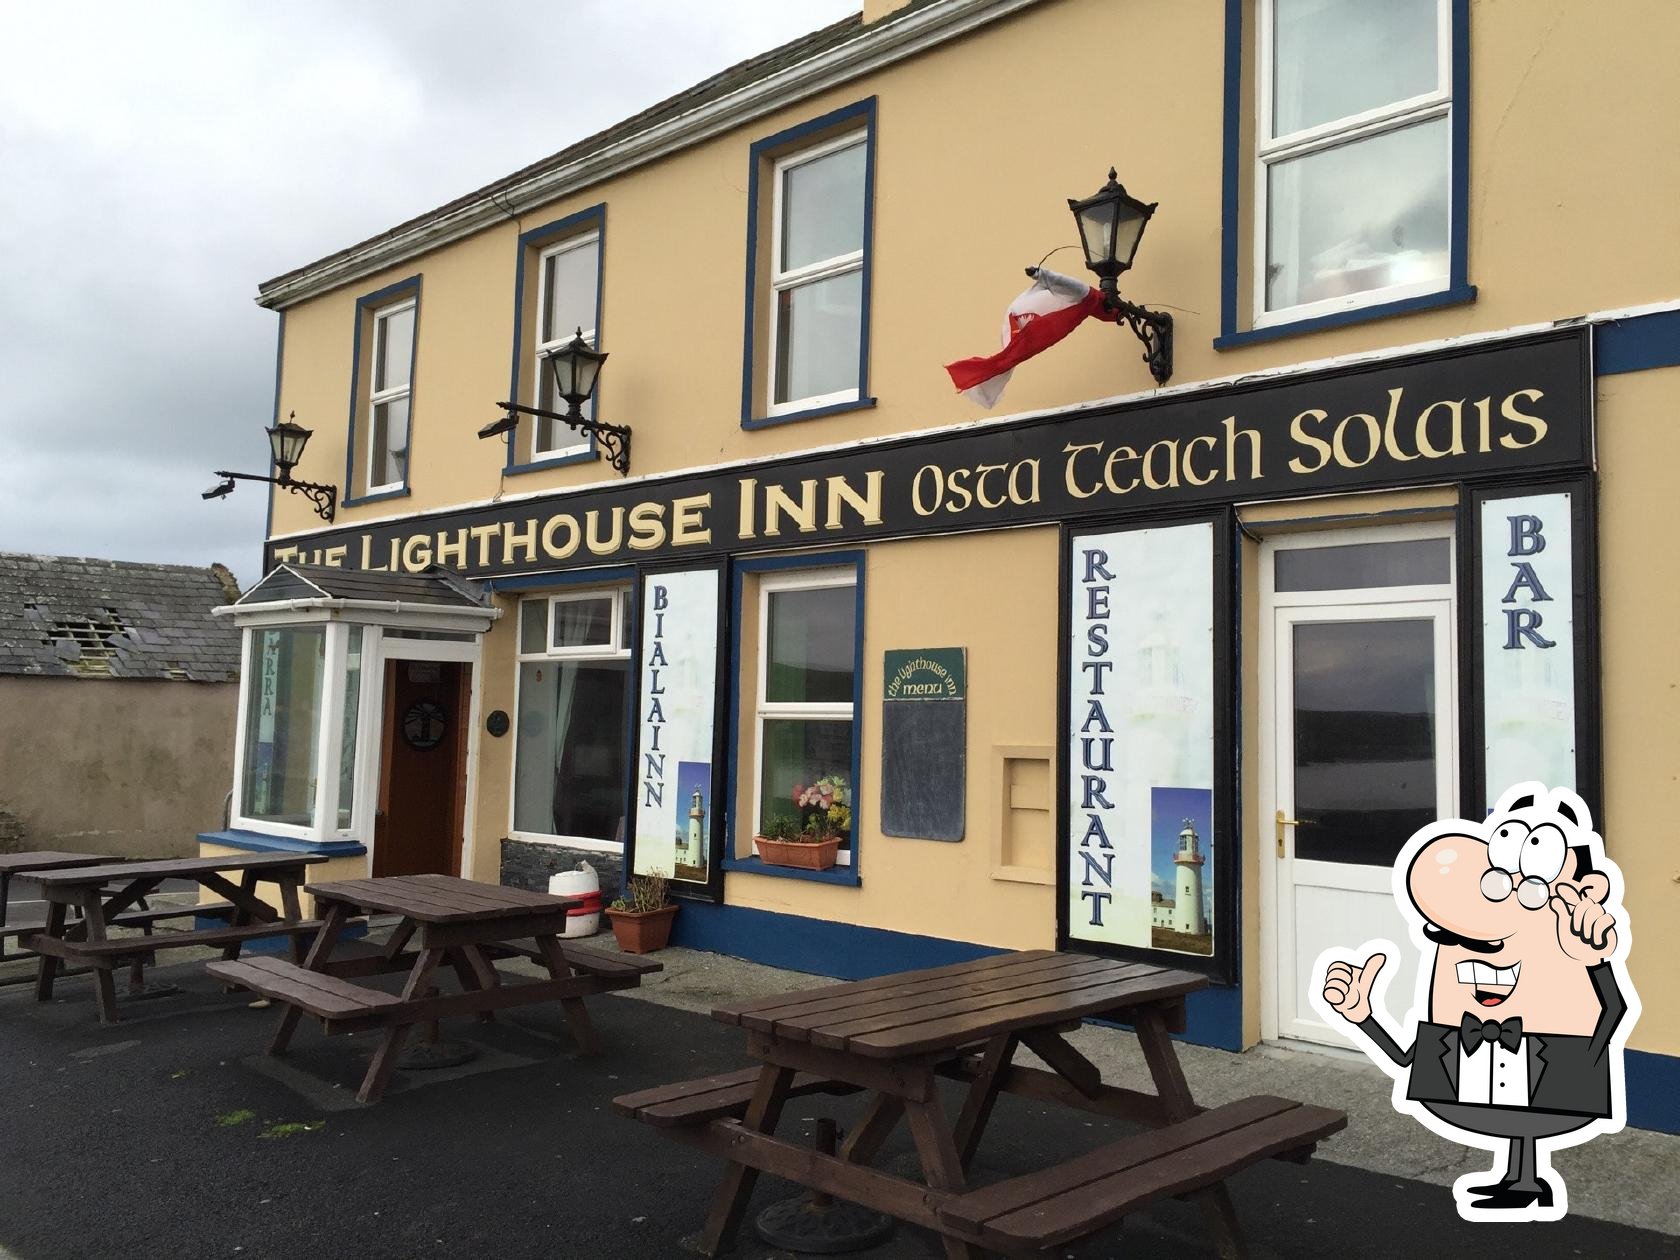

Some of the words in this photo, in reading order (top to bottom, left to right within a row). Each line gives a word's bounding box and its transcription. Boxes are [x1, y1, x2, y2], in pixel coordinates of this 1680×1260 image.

[361, 492, 711, 573] LIGHTHOUSE
[738, 470, 885, 540] INN
[1063, 416, 1264, 498] Teach
[1289, 387, 1548, 473] Solais
[1501, 514, 1557, 650] BAR
[643, 585, 669, 808] BIALAINN
[888, 676, 901, 697] the
[944, 674, 957, 696] inn
[903, 683, 942, 695] menu
[1078, 548, 1116, 927] RESTAURANT
